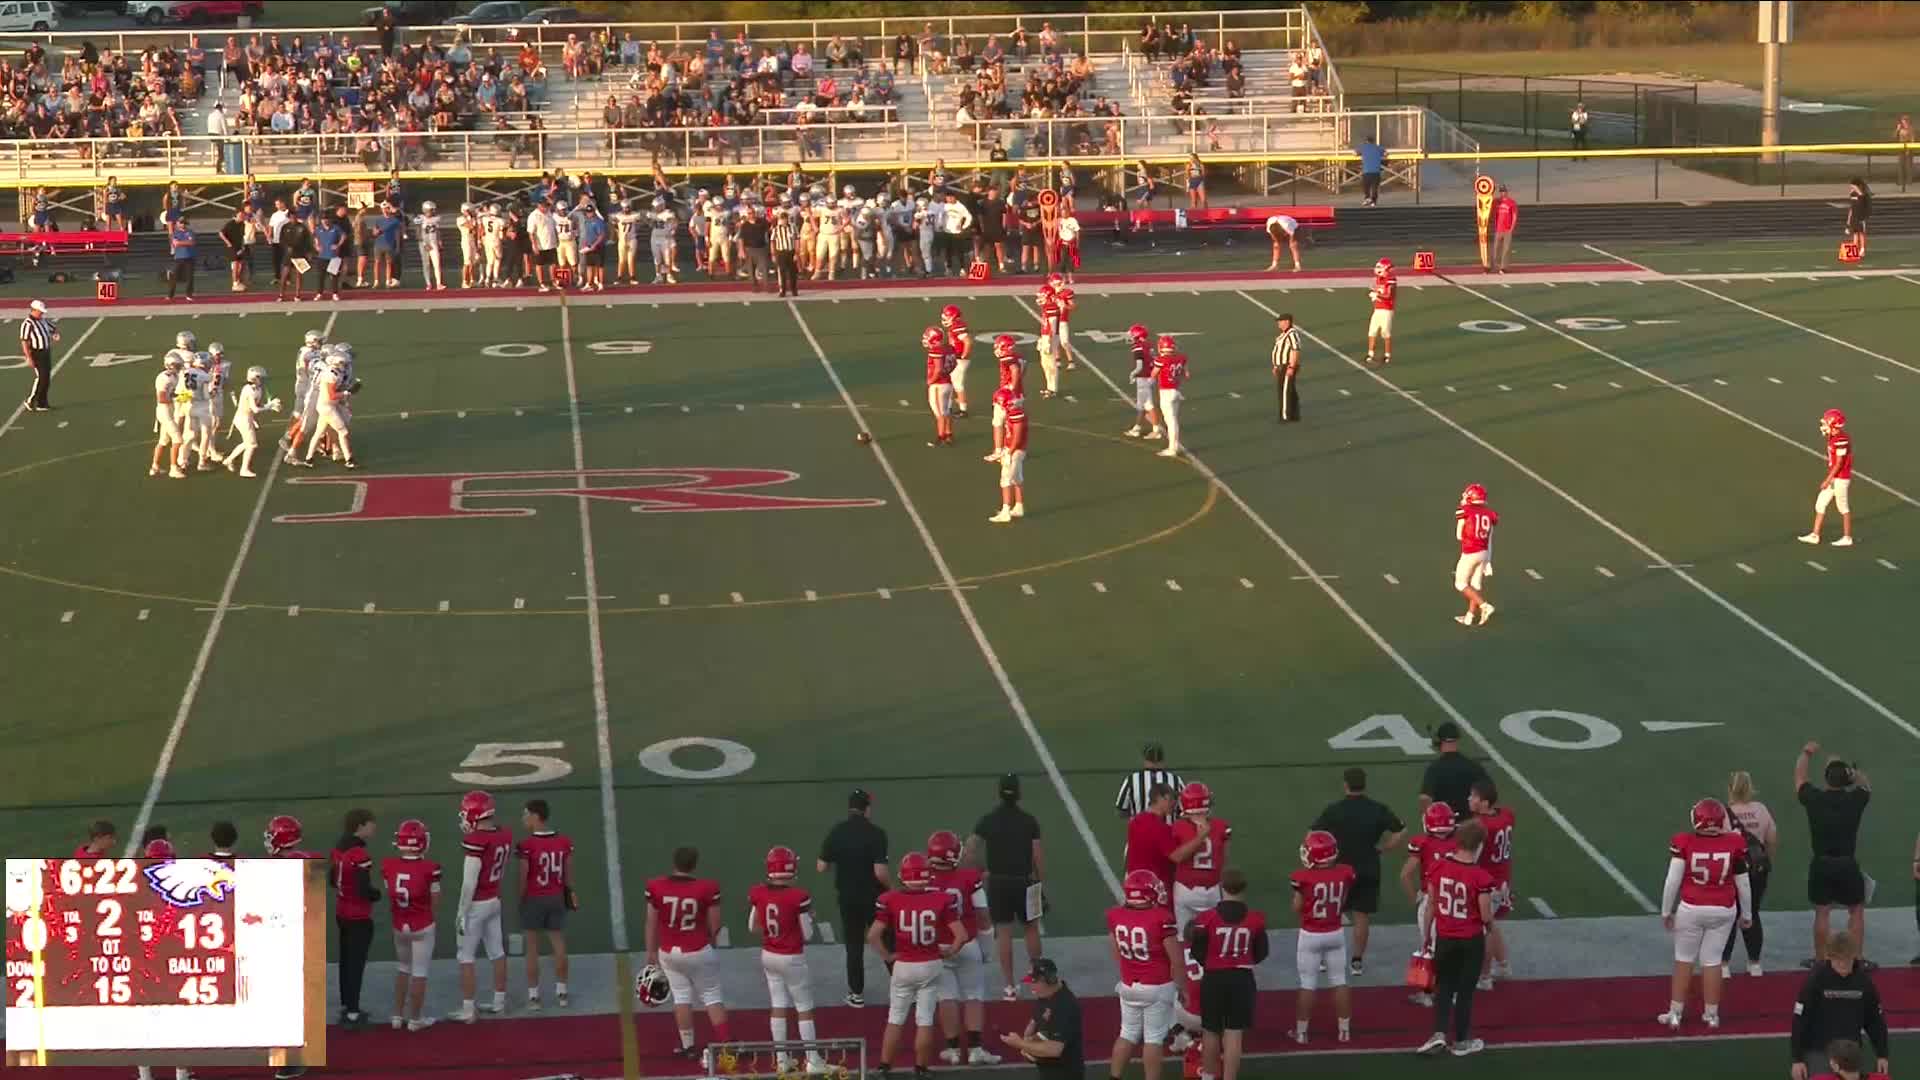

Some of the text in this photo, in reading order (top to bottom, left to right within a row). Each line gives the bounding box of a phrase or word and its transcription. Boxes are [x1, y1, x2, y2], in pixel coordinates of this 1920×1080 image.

[487, 220, 494, 233] 5
[1418, 254, 1433, 268] 30
[1845, 245, 1859, 258] 20
[969, 263, 984, 278] 40
[100, 283, 115, 299] 40
[1475, 513, 1491, 539] 19
[450, 737, 757, 786] 50
[60, 859, 137, 895] 6:22
[536, 850, 564, 887] 34
[1690, 851, 1731, 886] 57
[395, 873, 411, 908] 5
[1312, 881, 1344, 919] 24
[1438, 876, 1468, 919] 52
[65, 926, 78, 943] 3
[140, 925, 154, 942] 3
[178, 912, 226, 950] 13
[96, 899, 122, 937] 2
[662, 895, 699, 932] 72
[765, 903, 780, 938] 6
[899, 909, 937, 945] 46
[1114, 924, 1150, 961] 68
[1215, 926, 1251, 958] 70
[90, 956, 132, 973] TO GO
[168, 957, 226, 974] BALL ON
[1183, 947, 1204, 981] 5
[93, 976, 132, 1004] 15
[178, 976, 219, 1005] 45
